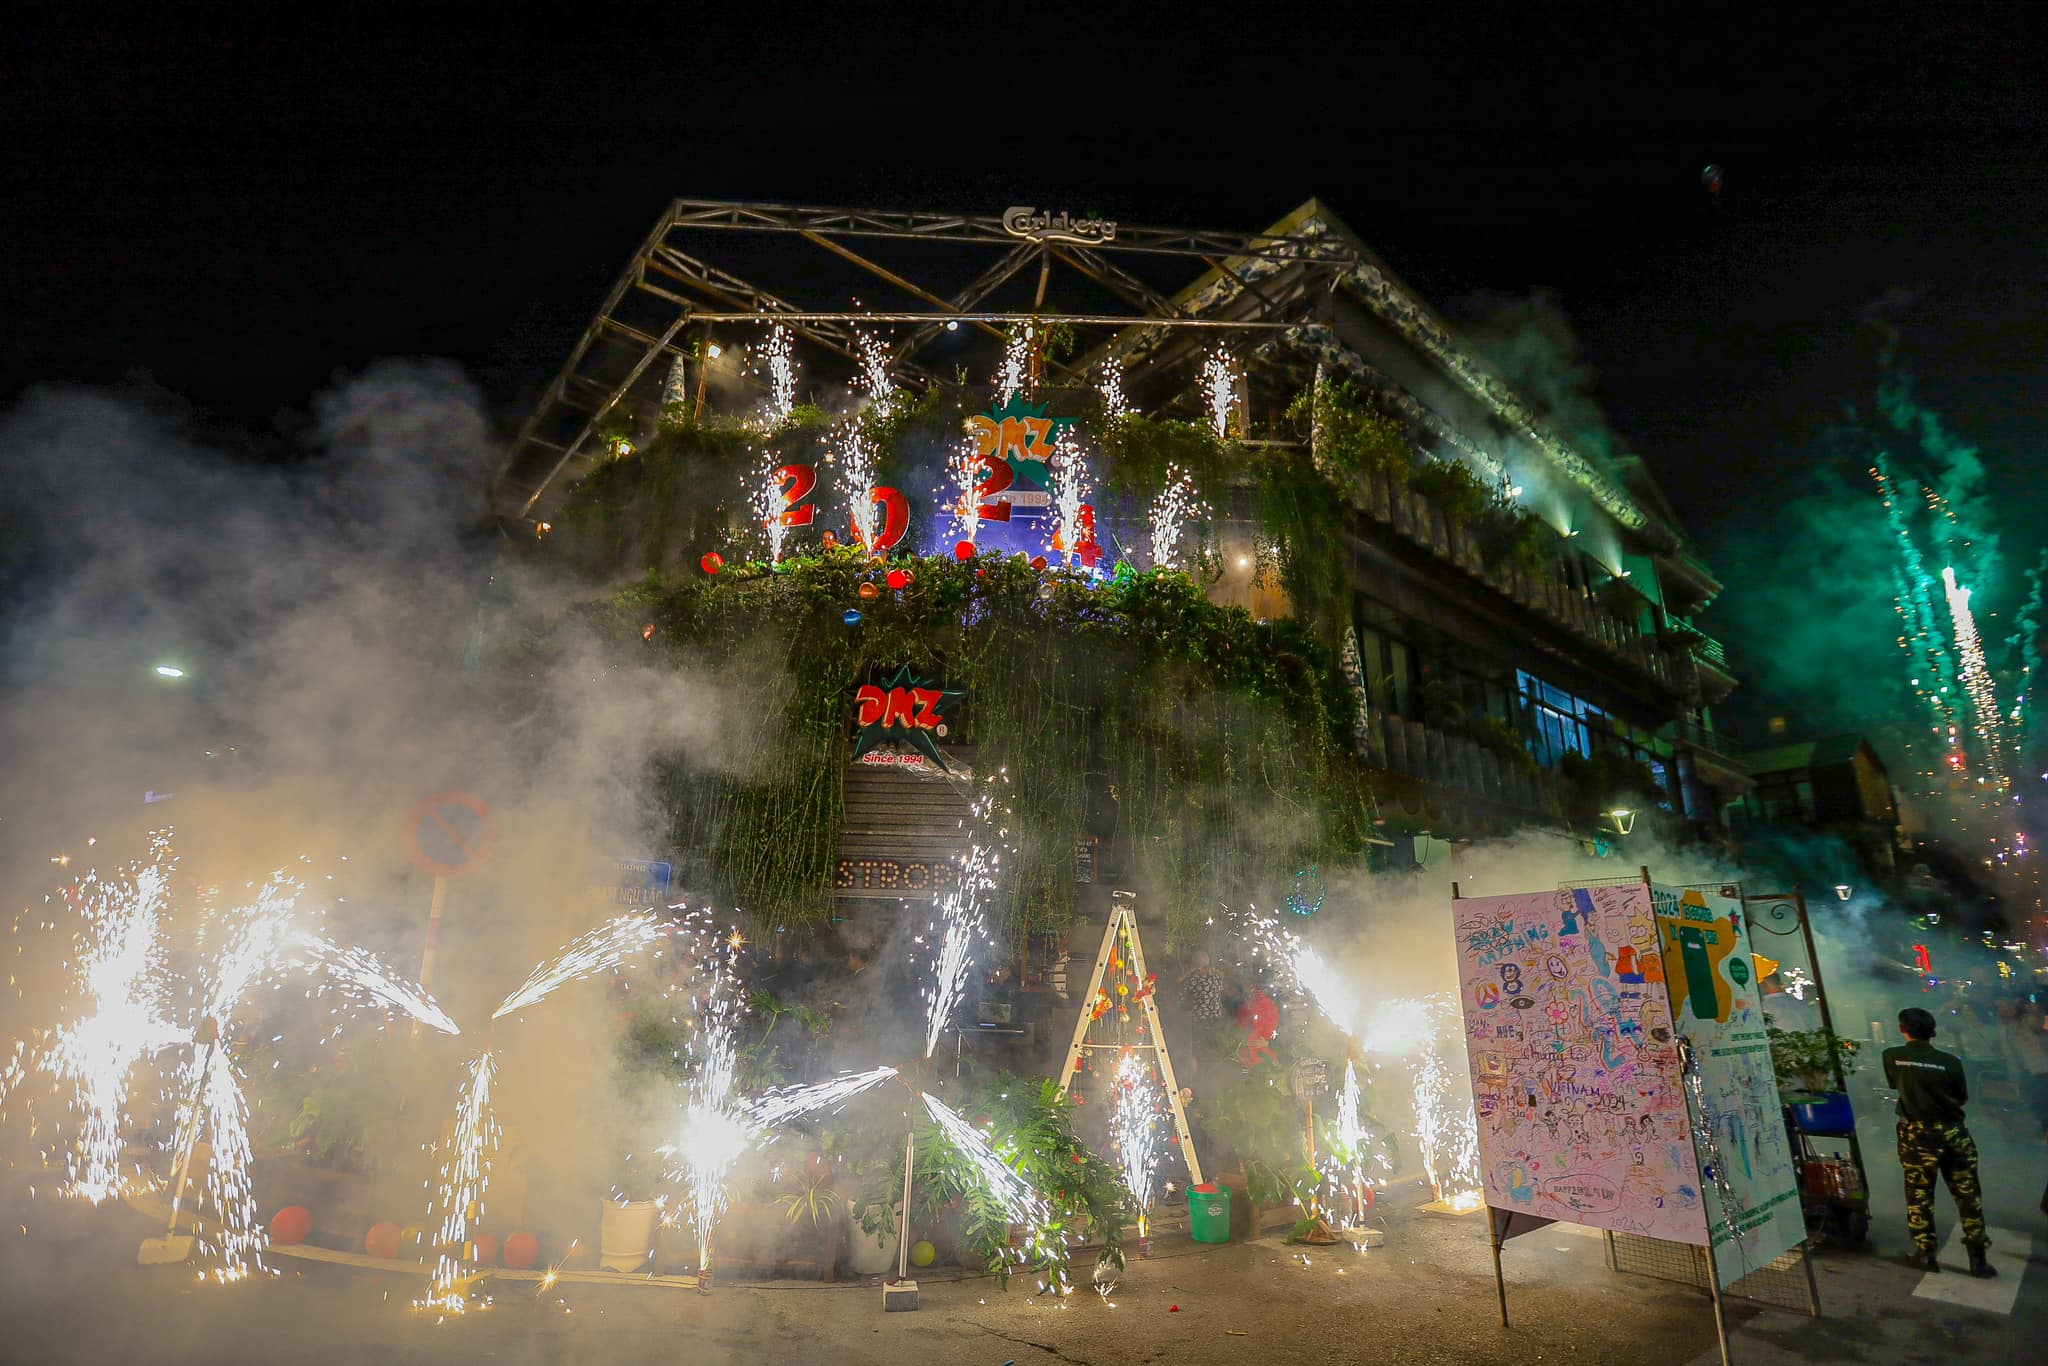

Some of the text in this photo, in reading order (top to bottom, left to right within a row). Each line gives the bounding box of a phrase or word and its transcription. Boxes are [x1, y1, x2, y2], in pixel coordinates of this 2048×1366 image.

[1002, 206, 1118, 243] Carlsberg
[970, 415, 1056, 462] DMZ
[855, 685, 943, 730] DMZ
[863, 753, 924, 765] Since 1994
[836, 861, 968, 889] STROP
[1654, 890, 1681, 917] 2024
